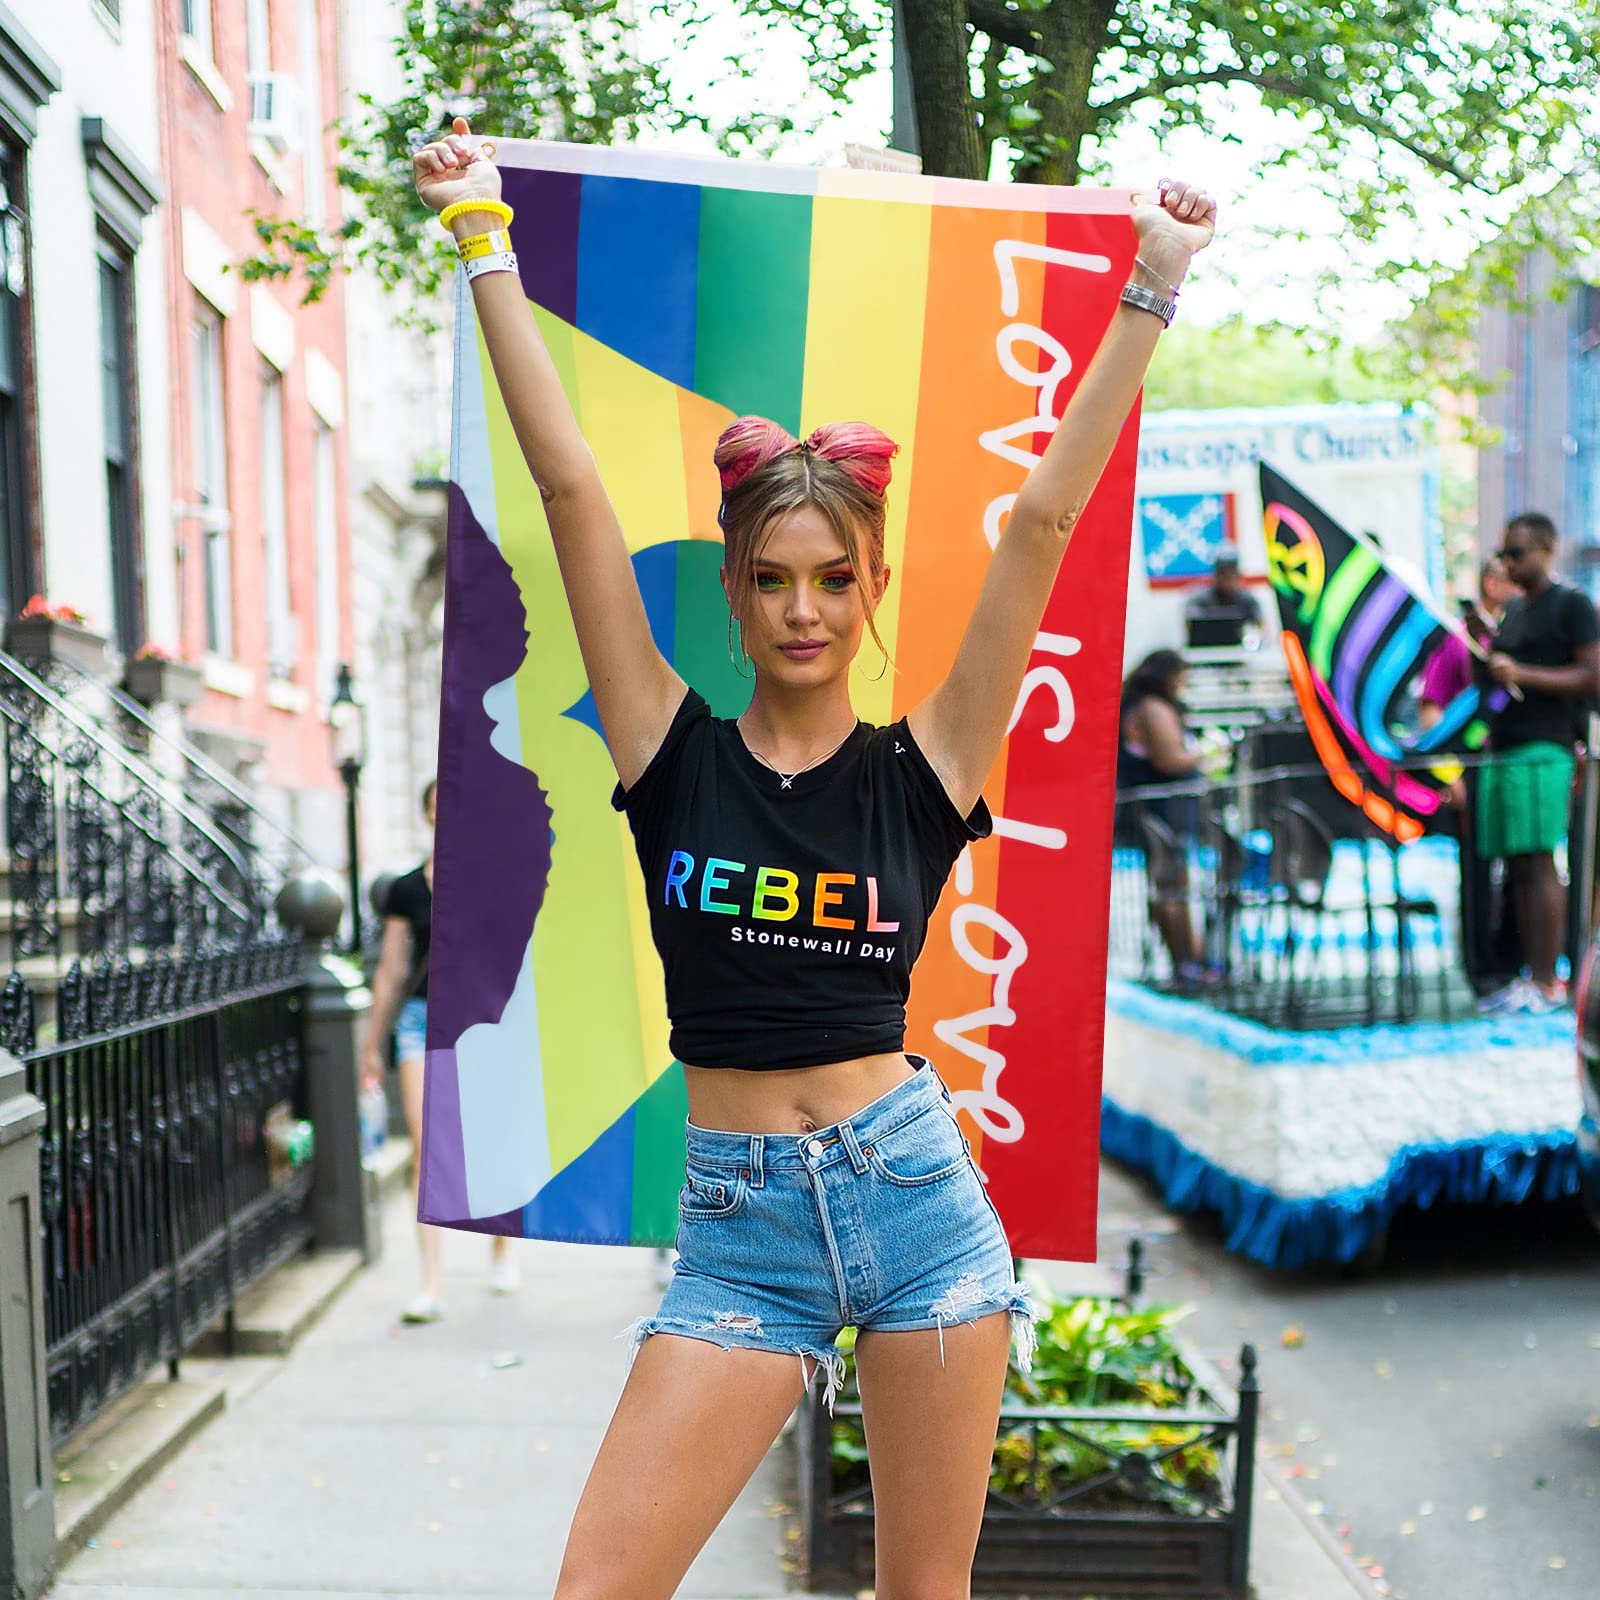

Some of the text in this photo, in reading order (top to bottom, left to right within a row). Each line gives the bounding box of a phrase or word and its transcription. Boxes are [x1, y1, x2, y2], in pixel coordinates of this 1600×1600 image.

[468, 237, 489, 247] Access
[1293, 422, 1421, 463] Church
[665, 850, 900, 933] REBEL
[731, 927, 896, 962] Stonewall Day
[933, 815, 1068, 1183] Love
